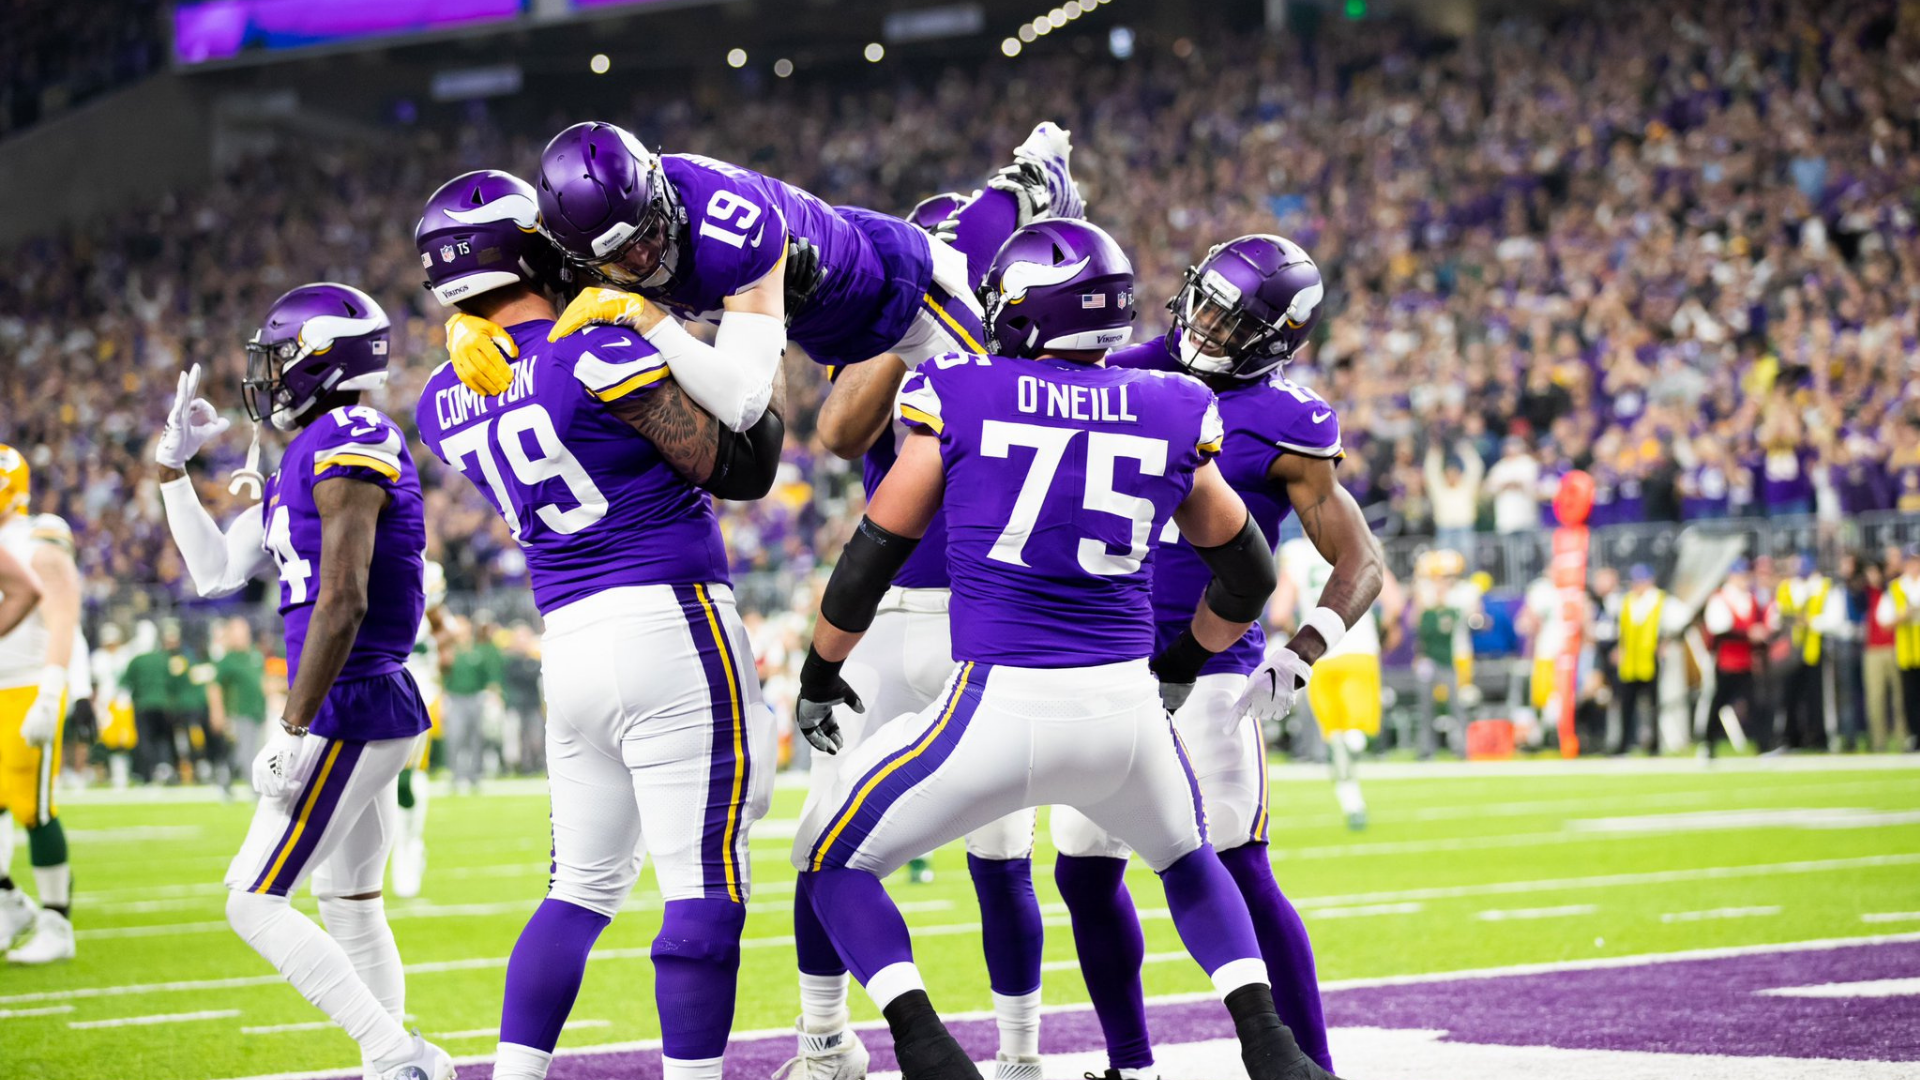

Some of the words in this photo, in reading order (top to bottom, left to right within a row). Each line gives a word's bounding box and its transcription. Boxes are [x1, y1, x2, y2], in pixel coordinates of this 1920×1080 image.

[457, 242, 470, 255] TS
[699, 190, 762, 249] 19
[435, 355, 537, 430] COMON
[1018, 375, 1137, 422] O'NEILL
[440, 404, 609, 547] 79
[980, 420, 1169, 576] 75
[262, 505, 312, 604] 4
